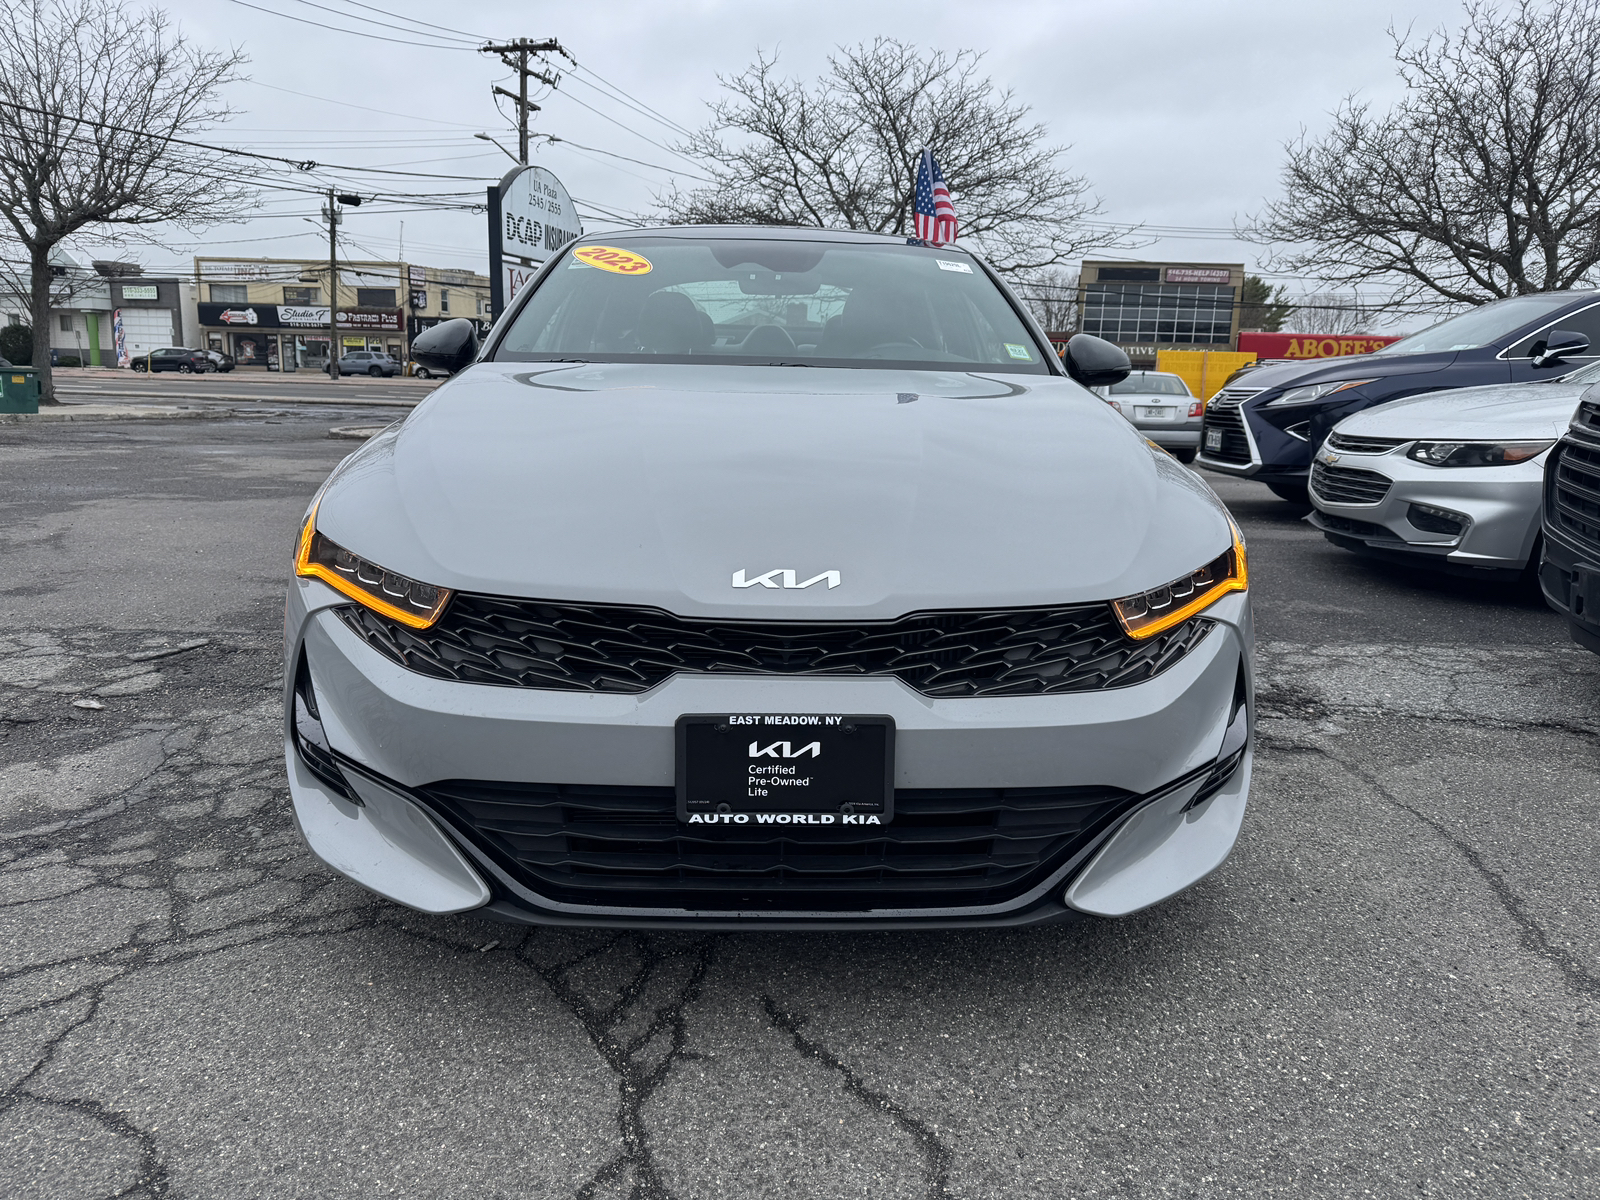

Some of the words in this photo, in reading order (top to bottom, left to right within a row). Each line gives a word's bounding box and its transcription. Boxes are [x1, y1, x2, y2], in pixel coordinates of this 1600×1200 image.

[533, 179, 542, 193] UA
[543, 184, 557, 199] Plaza
[506, 212, 542, 247] DCAP
[545, 224, 578, 252] INSURA
[576, 248, 648, 272] 2023
[280, 308, 314, 321] Studio
[381, 313, 398, 323] PLUS
[732, 568, 841, 590] KIA
[729, 716, 760, 725] EAST
[825, 716, 842, 726] NY
[748, 740, 821, 758] KIA
[748, 765, 796, 774] Certified
[748, 787, 768, 796] Lite
[688, 814, 750, 824] AUTO
[756, 814, 835, 824] WORLD
[842, 814, 881, 824] KIA
